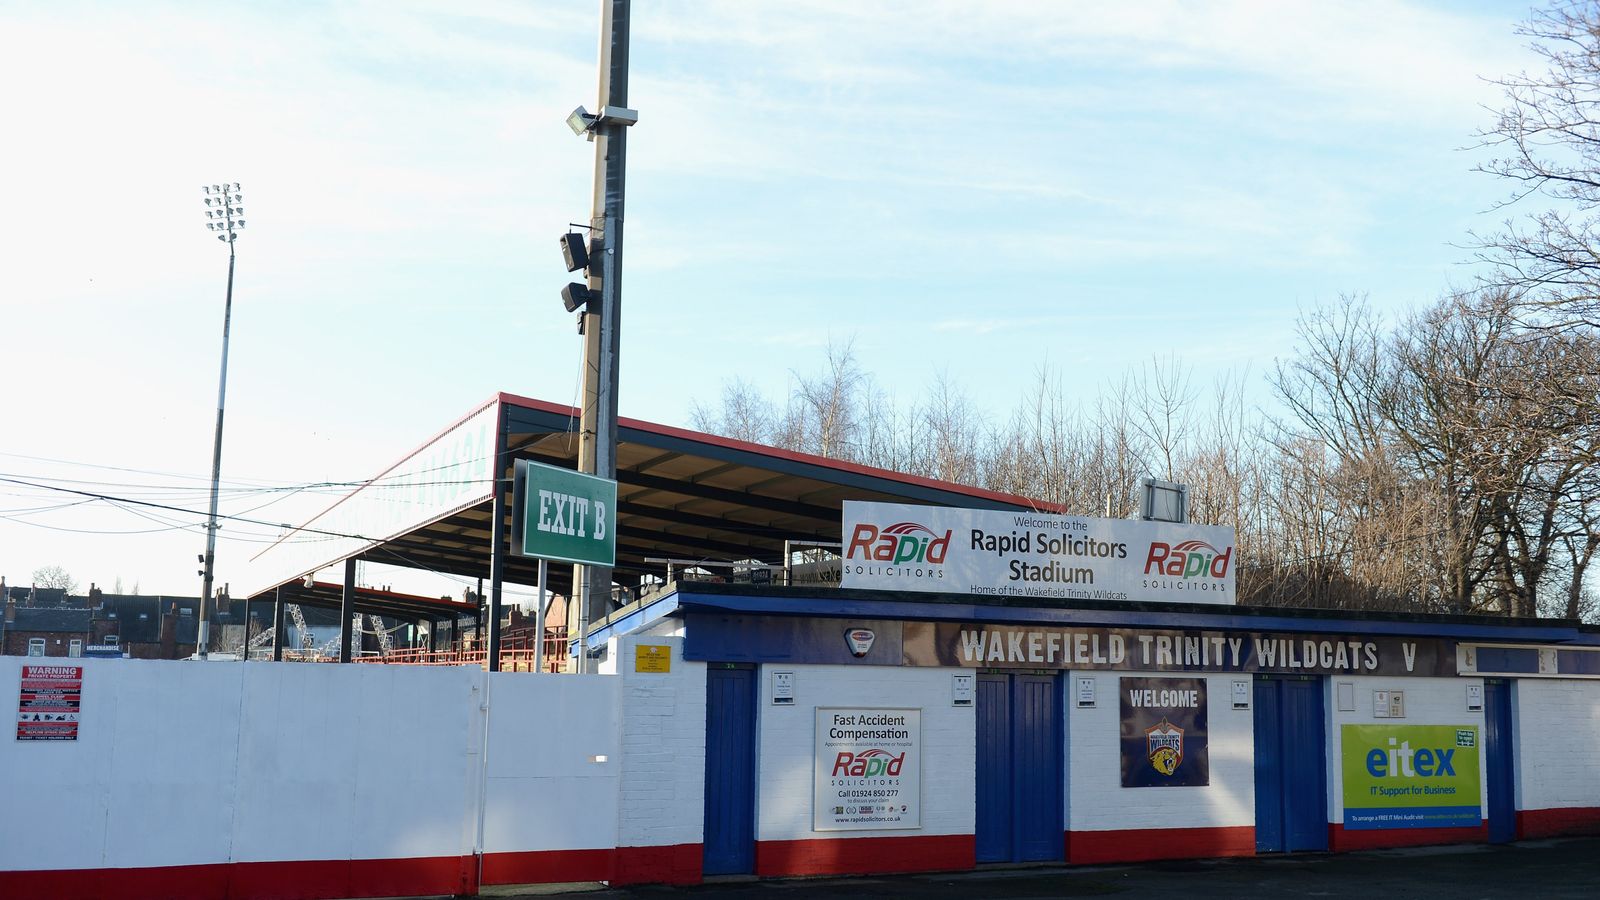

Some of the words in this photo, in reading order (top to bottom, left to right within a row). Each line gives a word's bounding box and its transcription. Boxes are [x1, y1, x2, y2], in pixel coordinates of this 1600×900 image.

[537, 489, 589, 538] EXIT
[594, 500, 606, 540] B
[1014, 516, 1058, 529] Welcome
[1060, 520, 1070, 530] to
[1072, 520, 1088, 531] the
[846, 522, 952, 565] Rapid
[970, 529, 1030, 558] Rapid
[1037, 534, 1128, 559] Solicitors
[1144, 541, 1232, 580] Rapid
[845, 566, 944, 579] SOLICITORS
[1009, 559, 1094, 584] Stadium
[970, 584, 996, 595] Home
[998, 585, 1008, 595] of
[1009, 586, 1023, 596] the
[1024, 586, 1065, 598] Wakefield
[1066, 588, 1092, 600] Trinity
[1094, 590, 1128, 600] Wildcats
[1143, 580, 1225, 592] SOLICITORS
[961, 630, 1125, 664] WAKEFIELD
[1138, 634, 1242, 667] TRINITY
[1255, 638, 1378, 670] WILDCATS
[1402, 642, 1416, 672] V
[1130, 690, 1198, 708] WELCOME
[834, 714, 856, 726] Fast
[858, 714, 905, 726] Accident
[830, 728, 908, 741] Compensation
[1150, 739, 1179, 752] WILDCATS
[832, 750, 906, 778] Rapid
[1366, 737, 1456, 778] eitex
[1370, 786, 1378, 796] IT
[1380, 786, 1411, 798] Support
[1412, 785, 1422, 795] for
[1424, 785, 1456, 794] Business
